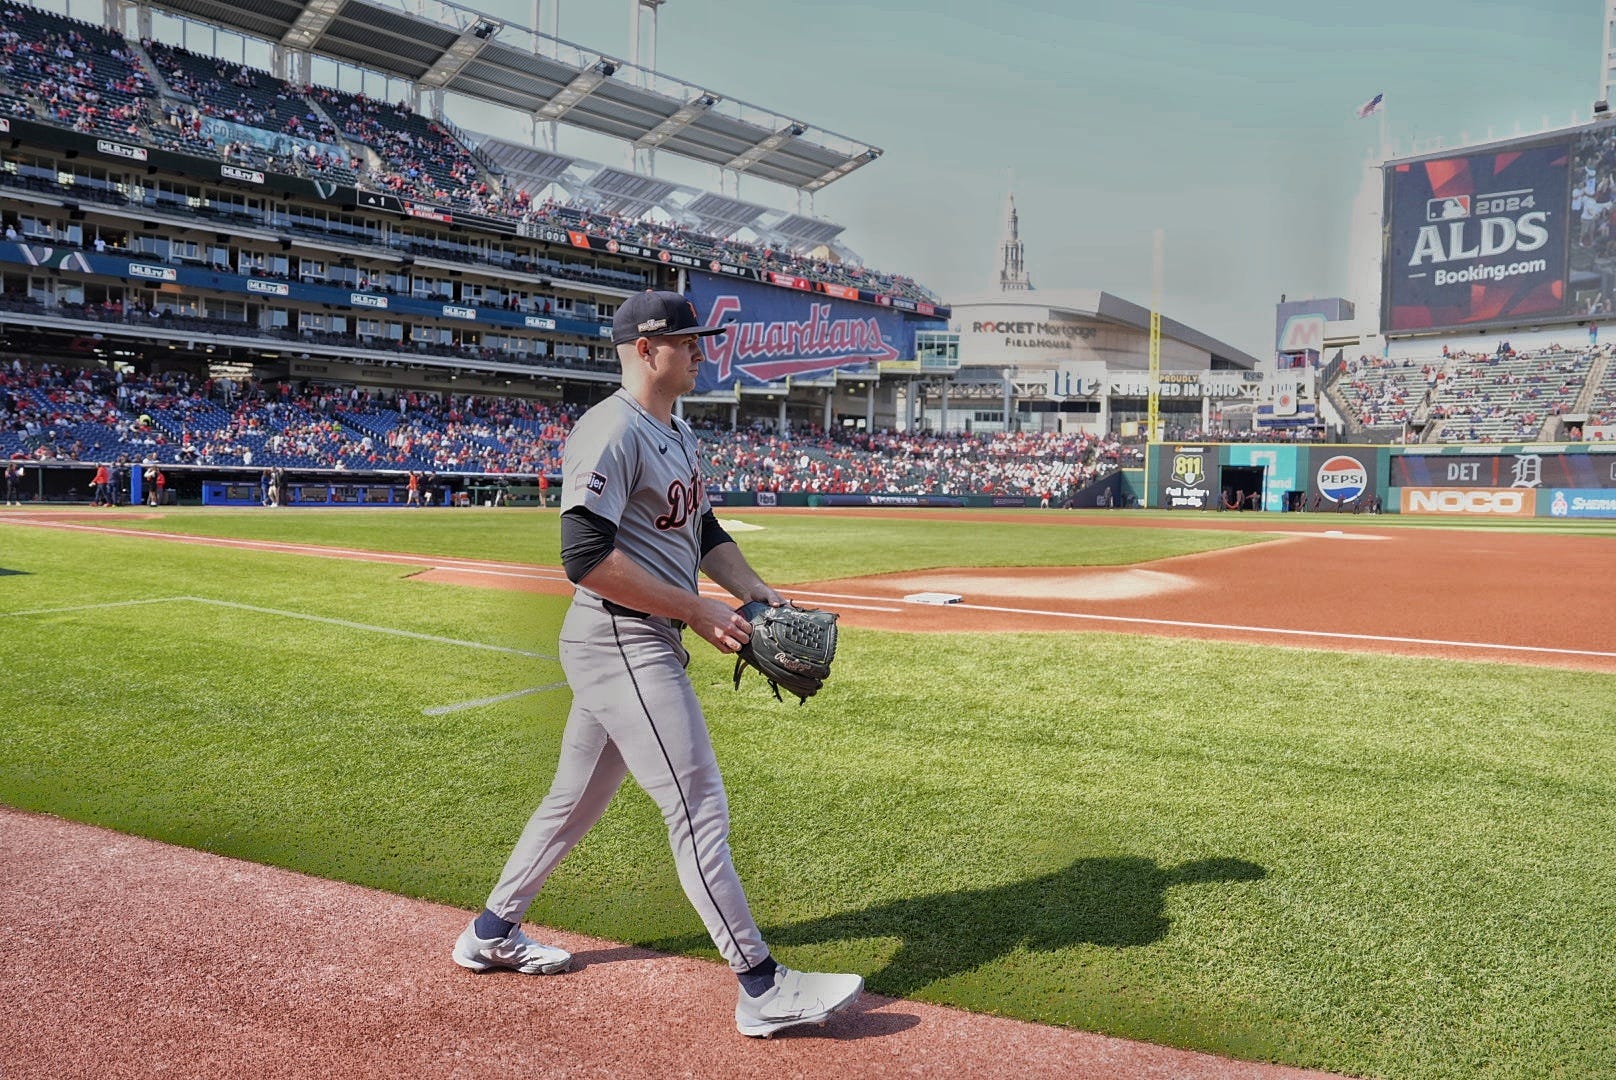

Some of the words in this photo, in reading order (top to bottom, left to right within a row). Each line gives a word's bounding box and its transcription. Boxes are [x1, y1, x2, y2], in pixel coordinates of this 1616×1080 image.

[1475, 195, 1535, 215] 2024
[1407, 211, 1549, 267] ALDS
[1434, 258, 1547, 286] Booking.com
[703, 295, 885, 383] Guardians
[973, 321, 1035, 334] ROCKET
[1036, 322, 1097, 339] Mortgage
[1047, 369, 1101, 402] Lite
[1159, 375, 1199, 383] PROUDLY
[1184, 383, 1200, 397] IN
[1203, 383, 1239, 397] OHIO
[1175, 456, 1200, 475] 811
[1447, 462, 1480, 481] DET
[1321, 474, 1363, 484] PEPSI
[1410, 491, 1522, 513] NOCO
